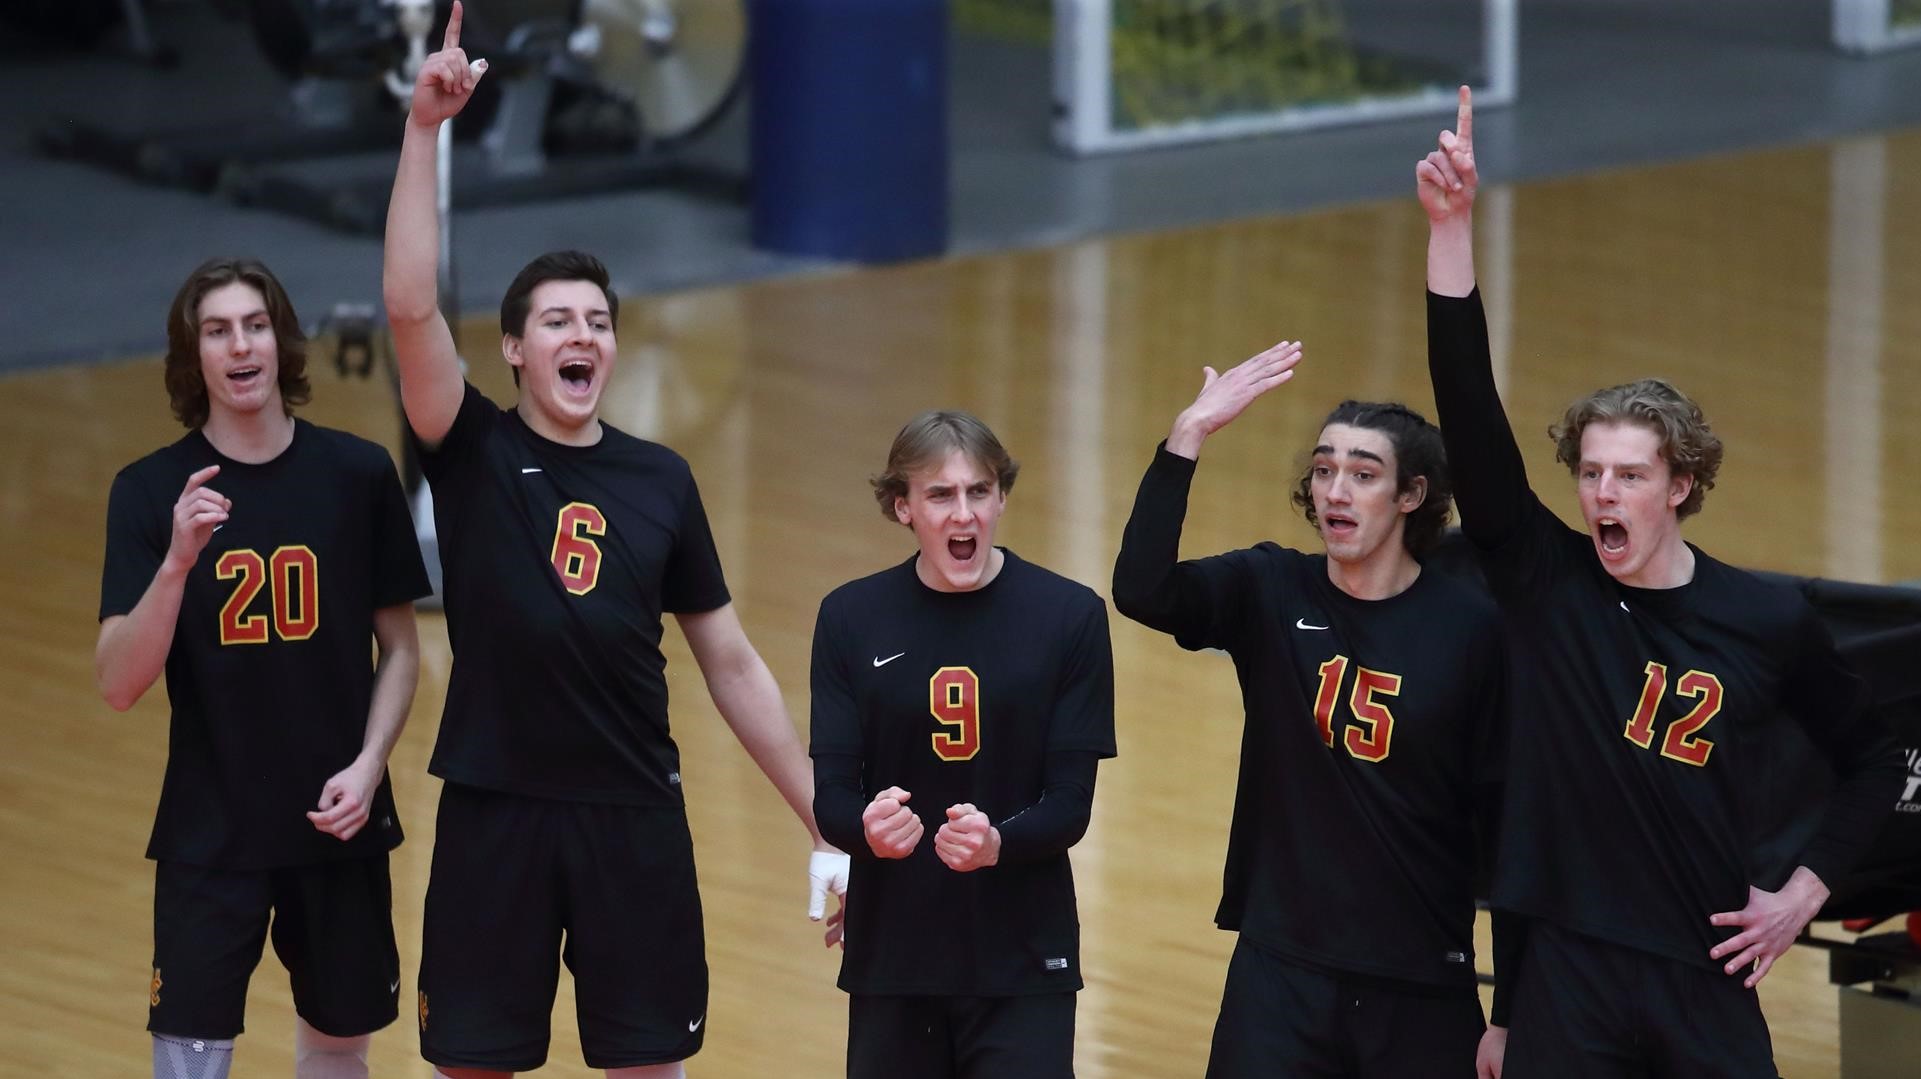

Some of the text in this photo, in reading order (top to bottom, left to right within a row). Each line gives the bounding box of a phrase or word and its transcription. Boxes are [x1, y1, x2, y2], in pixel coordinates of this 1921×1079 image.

[216, 546, 319, 645] 20
[551, 502, 607, 596] 6
[930, 666, 981, 761] 9
[1313, 655, 1401, 762] 15
[1624, 660, 1725, 767] 12
